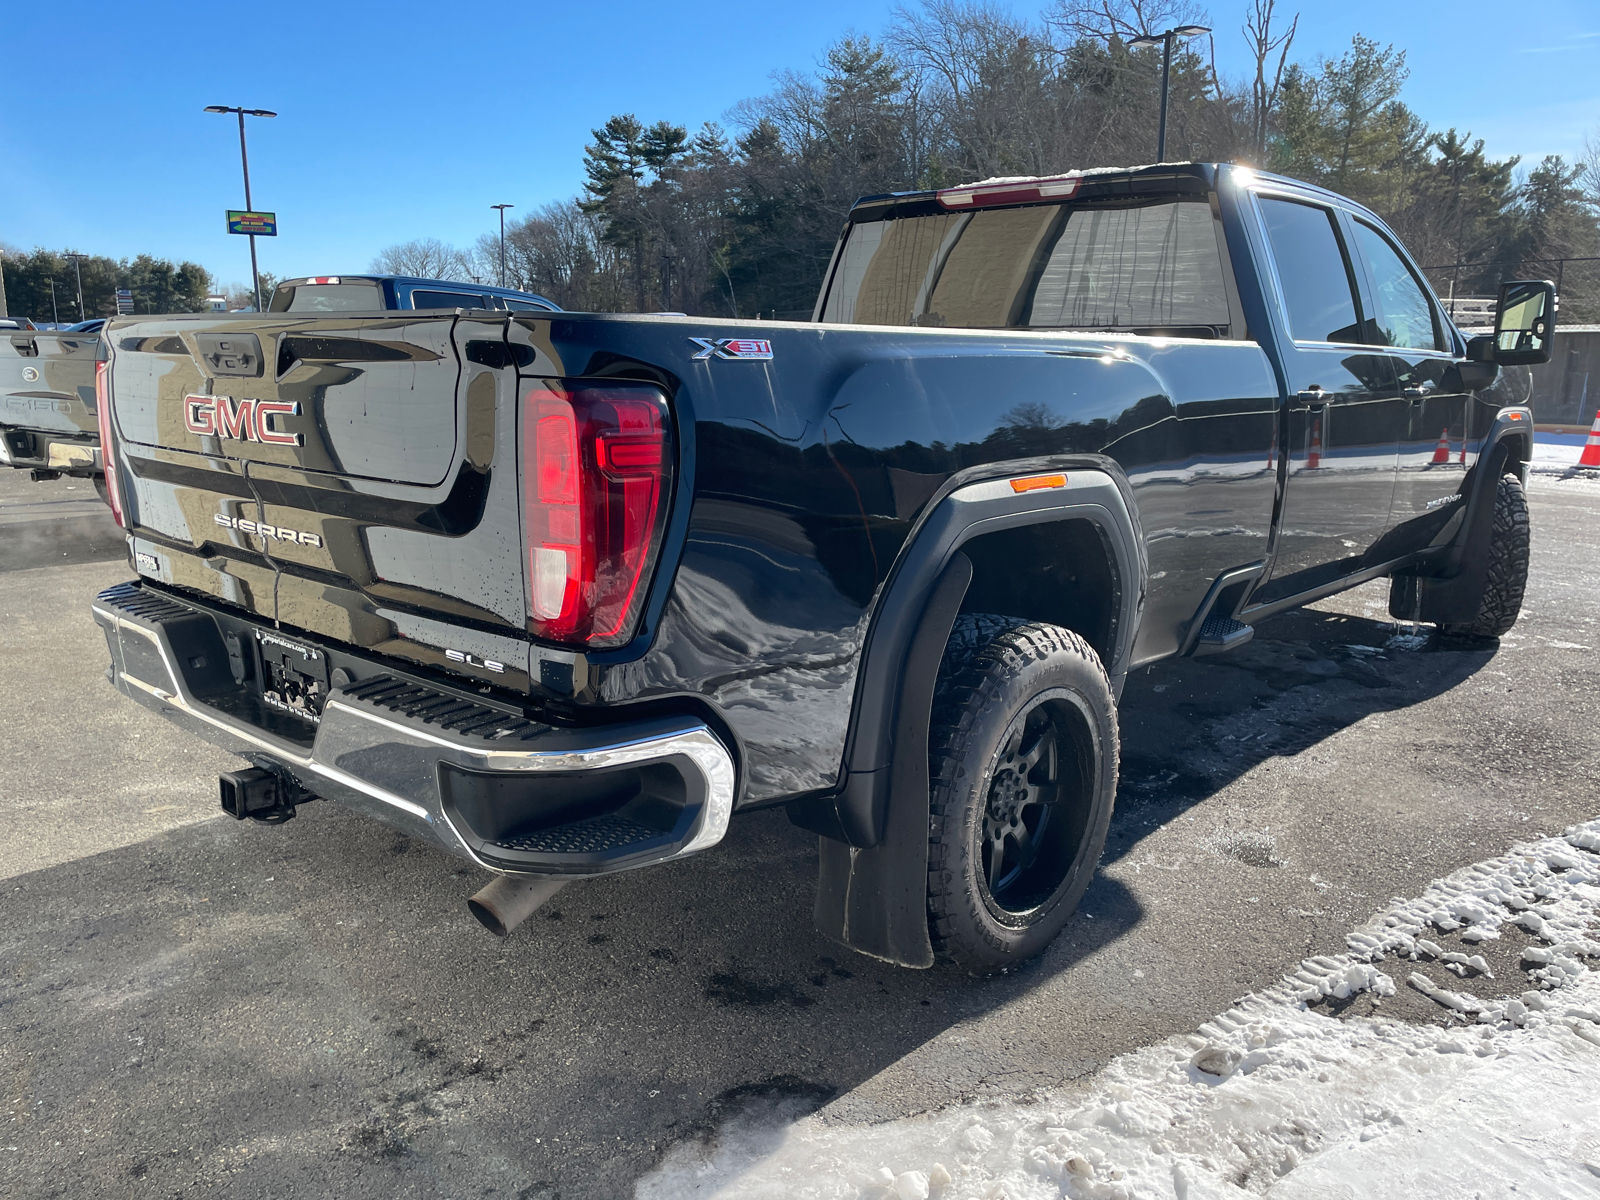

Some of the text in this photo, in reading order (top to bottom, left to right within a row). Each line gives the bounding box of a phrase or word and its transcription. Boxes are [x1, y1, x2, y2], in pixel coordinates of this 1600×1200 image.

[6, 398, 72, 414] F-150
[185, 392, 302, 447] GMC
[214, 513, 323, 548] SIERRA
